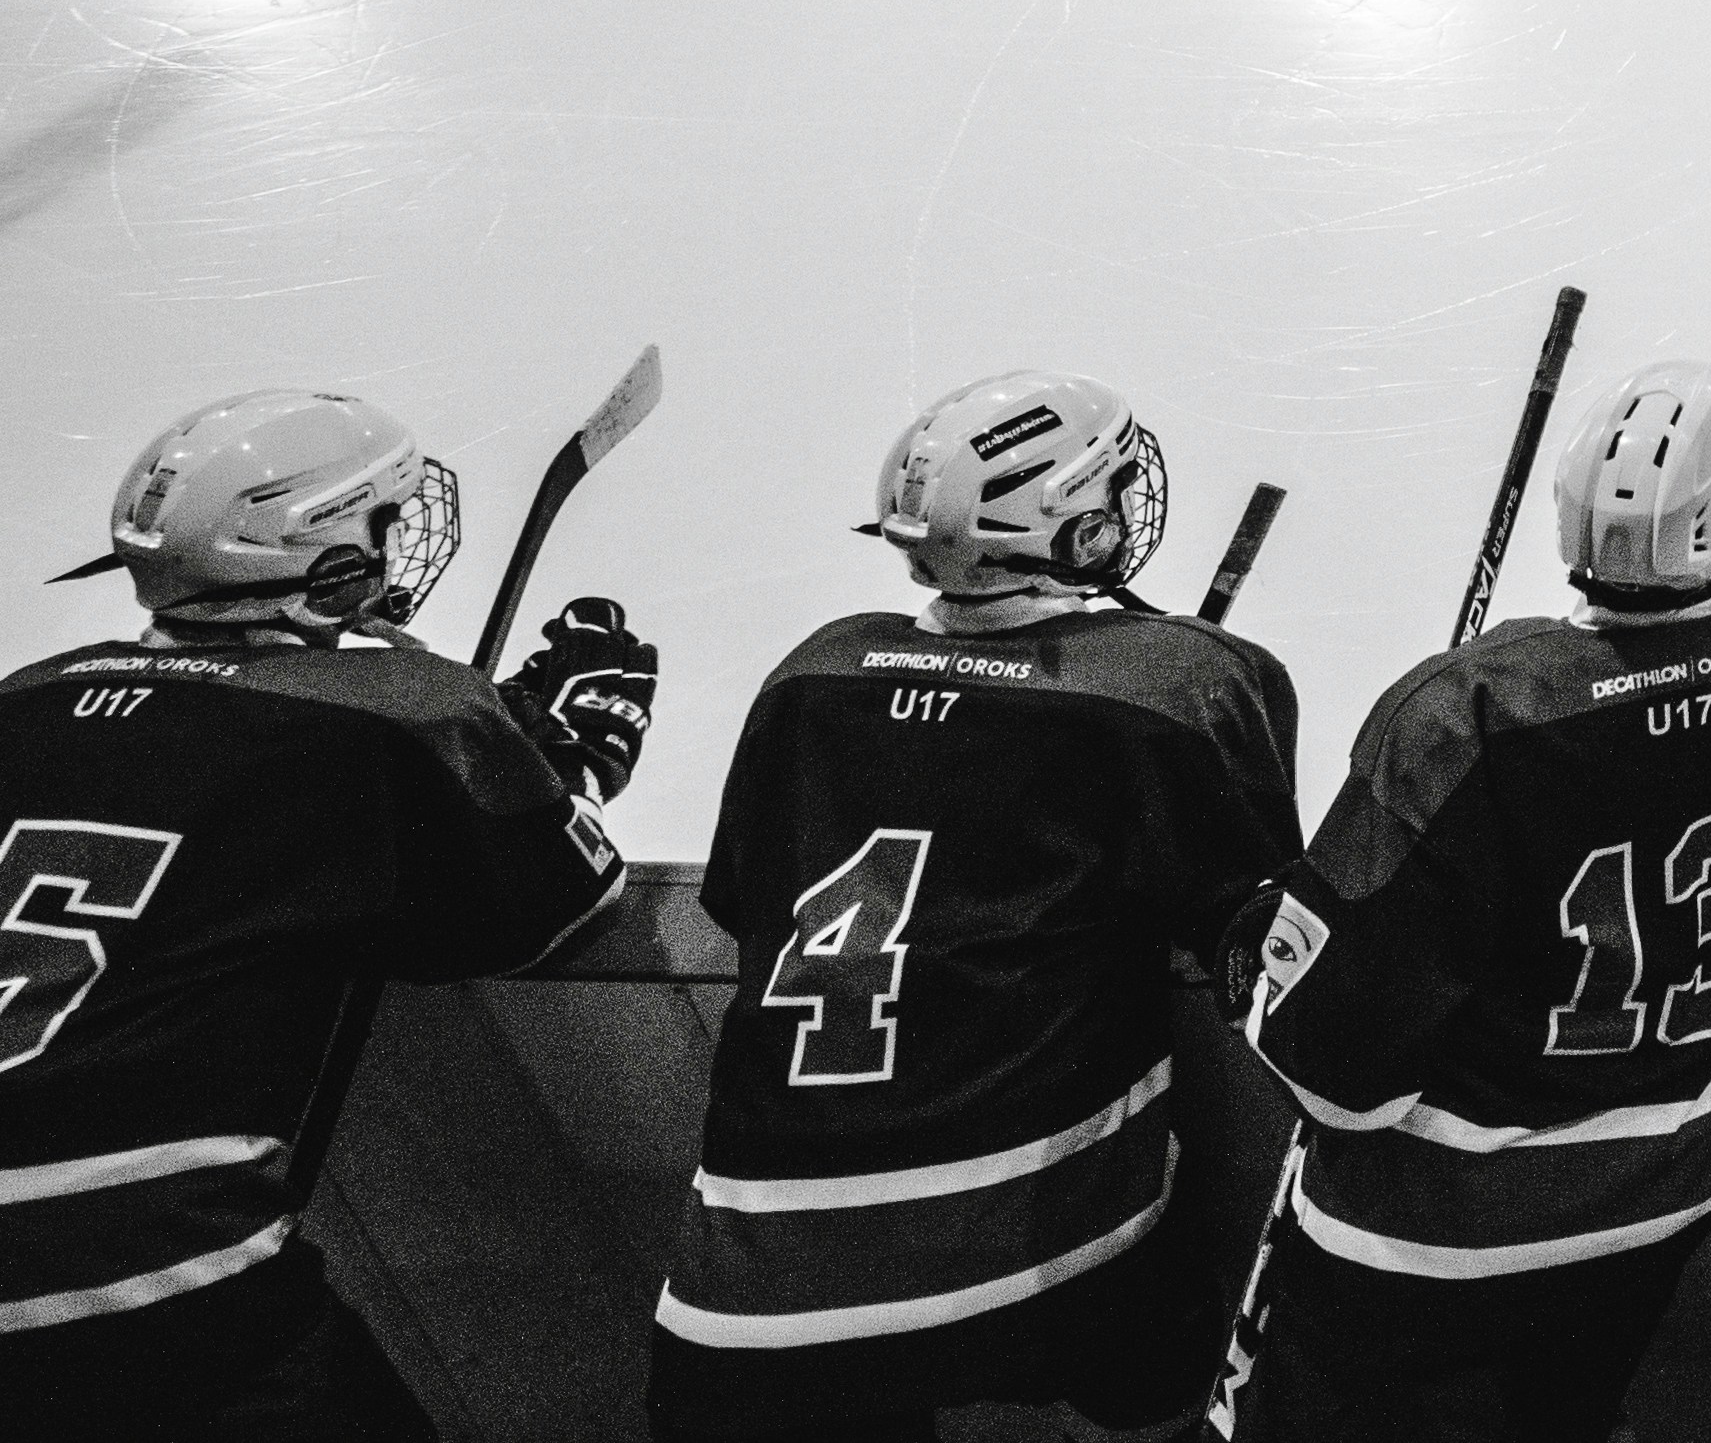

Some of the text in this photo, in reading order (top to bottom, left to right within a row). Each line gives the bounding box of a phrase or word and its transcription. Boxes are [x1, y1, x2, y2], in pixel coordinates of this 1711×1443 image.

[157, 657, 240, 677] OROKS
[862, 651, 1034, 681] DECATHLON OROKS
[1591, 662, 1688, 701] DECATHLON
[73, 688, 154, 718] U17
[890, 688, 961, 722] U17
[760, 827, 933, 1087] 4
